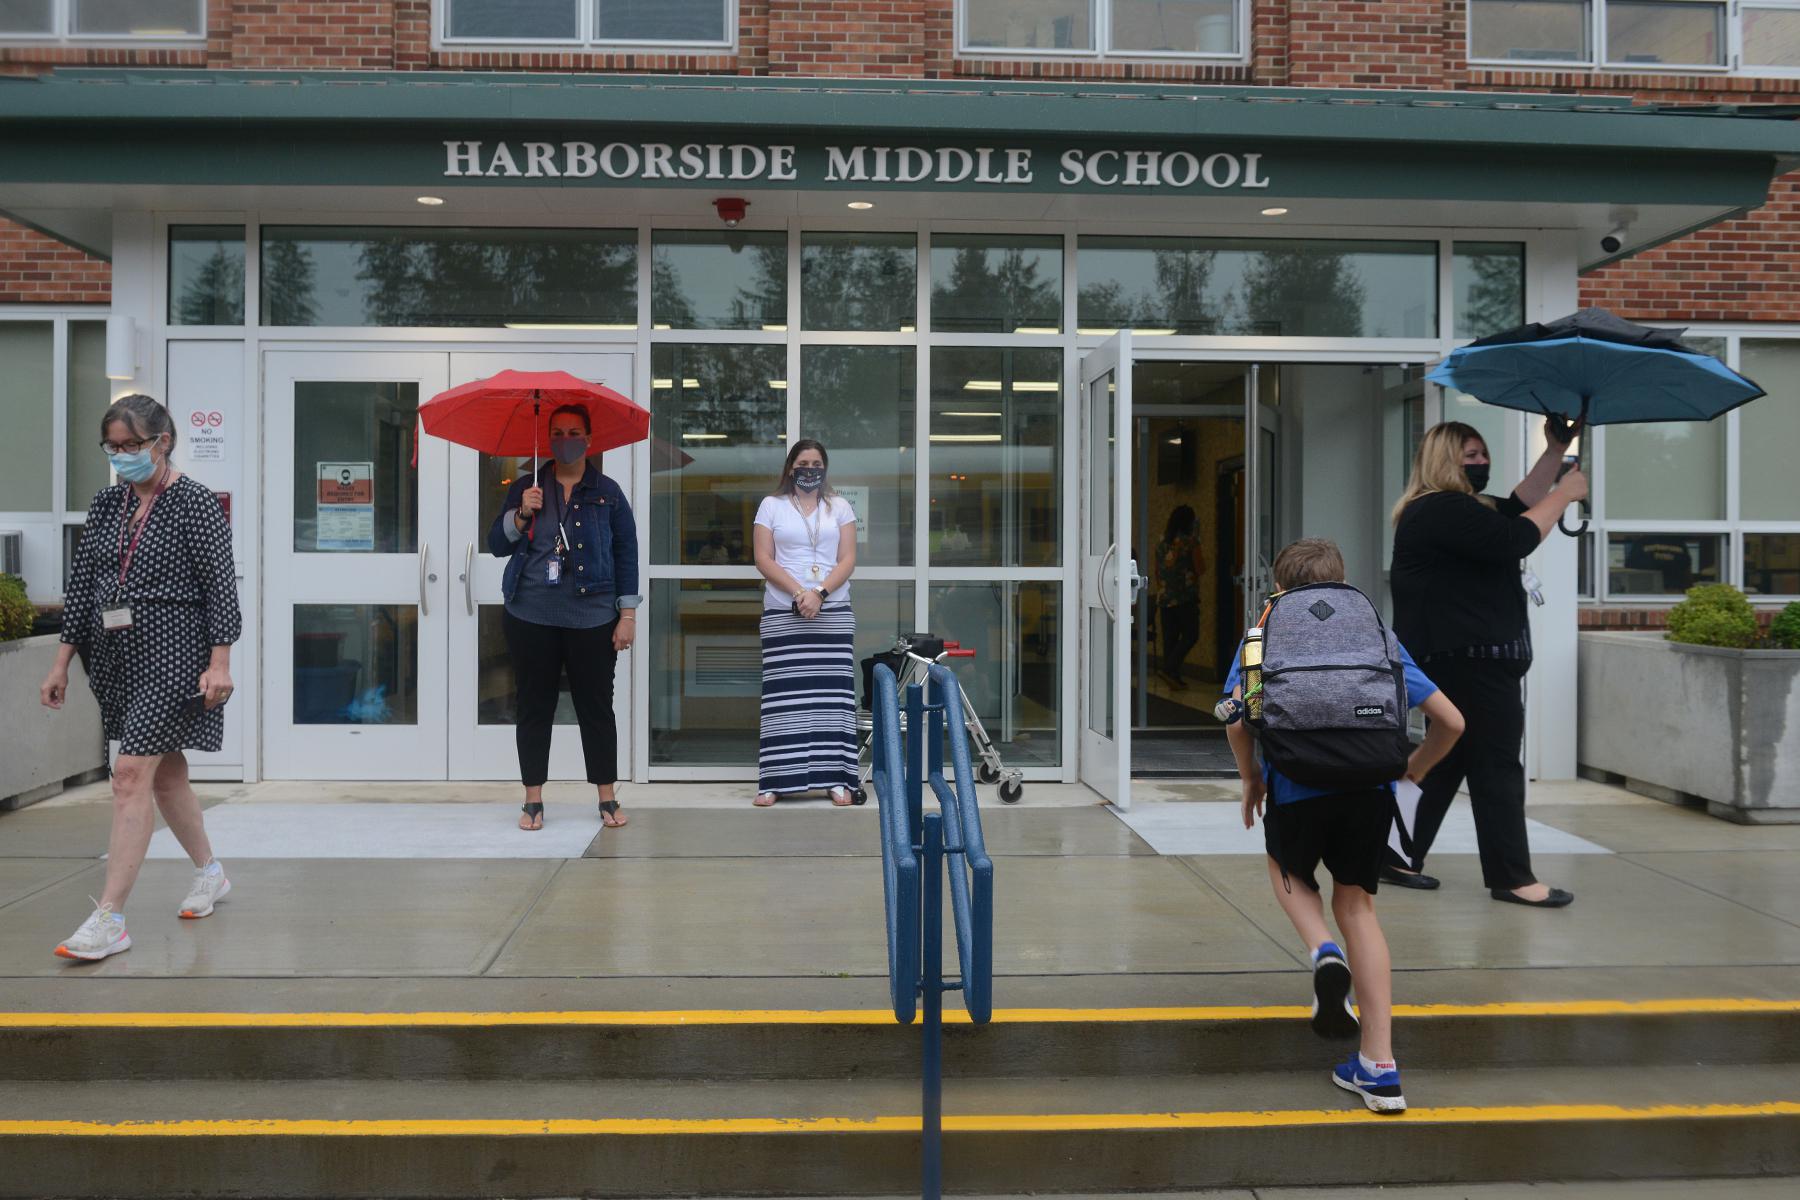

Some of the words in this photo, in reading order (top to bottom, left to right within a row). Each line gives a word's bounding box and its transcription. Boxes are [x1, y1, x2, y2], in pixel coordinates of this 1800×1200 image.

[443, 140, 797, 181] HARBORSIDE
[824, 145, 1033, 184] MIDDLE
[1059, 149, 1270, 189] SCHOOL
